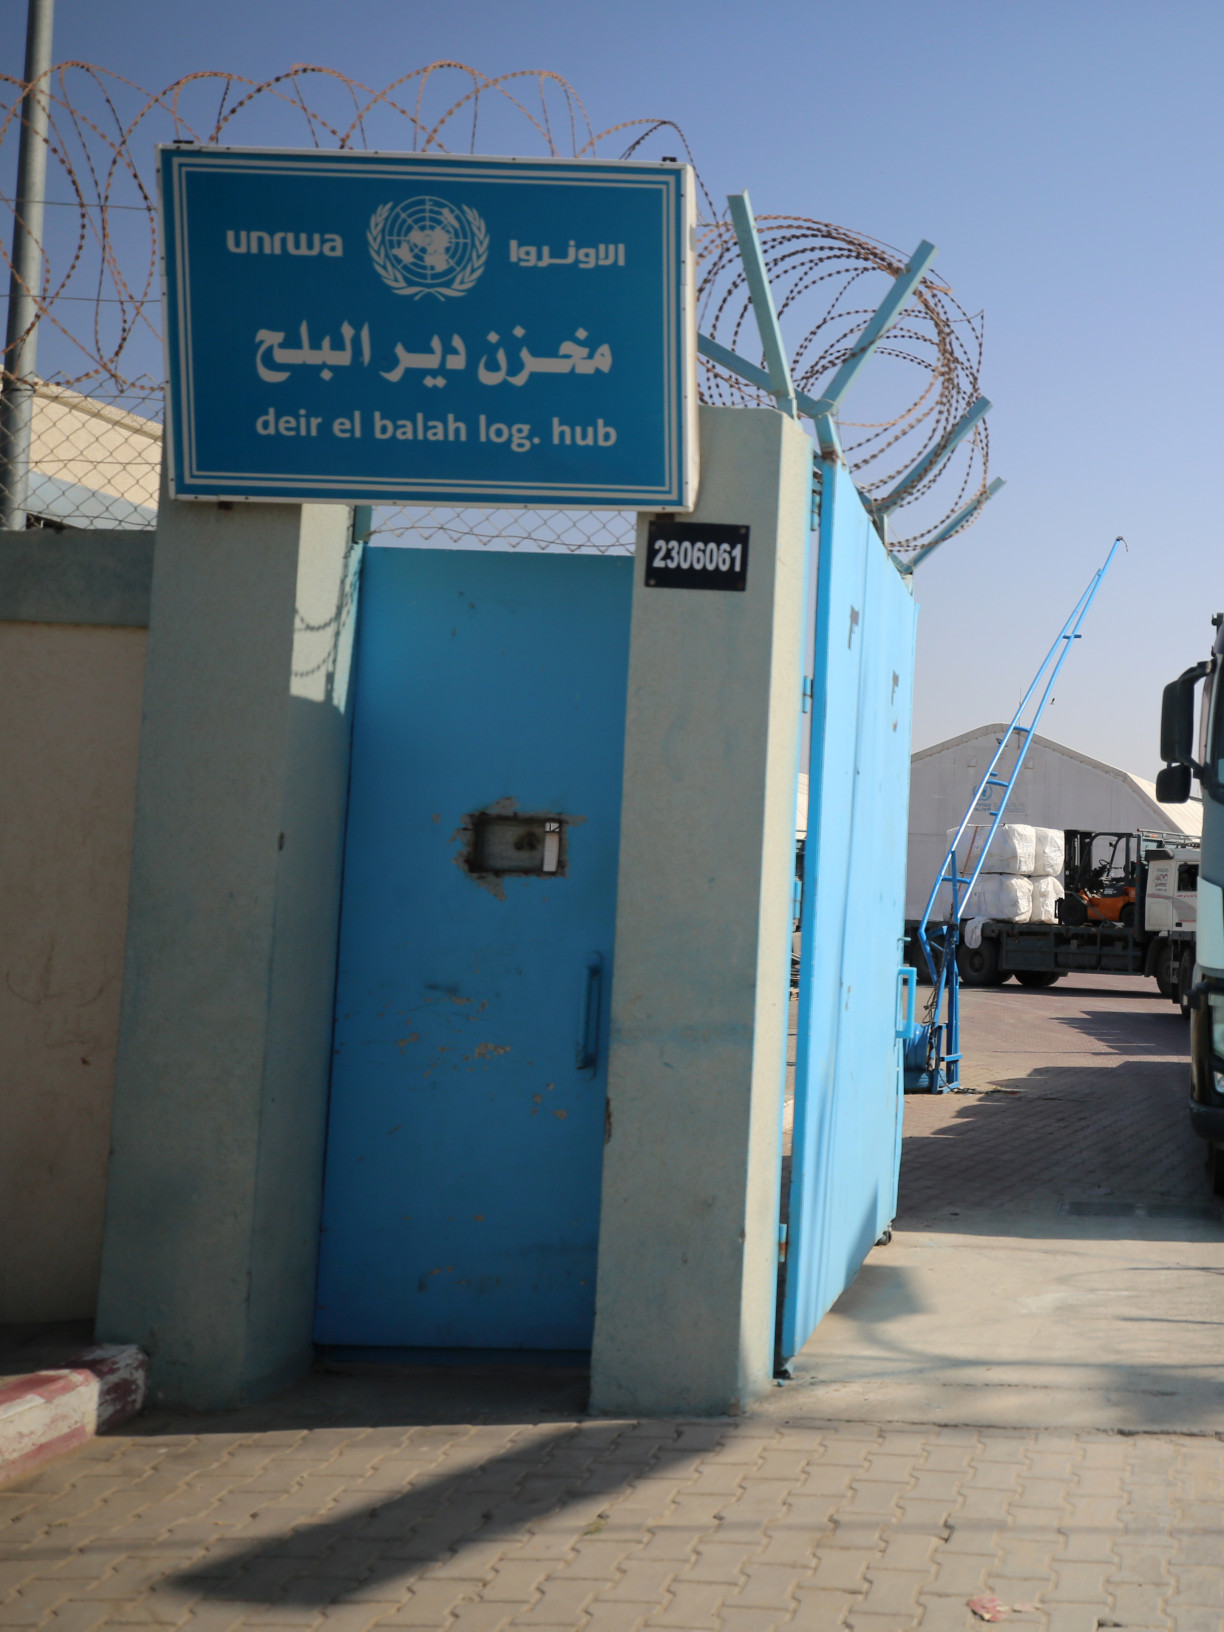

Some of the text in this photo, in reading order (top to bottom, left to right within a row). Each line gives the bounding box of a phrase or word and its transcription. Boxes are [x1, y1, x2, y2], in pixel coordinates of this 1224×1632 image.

[226, 230, 343, 257] unrwa
[254, 319, 613, 389] مخزن دير البلح
[255, 407, 618, 453] deir el balah log. hub
[652, 539, 742, 572] 2306061
